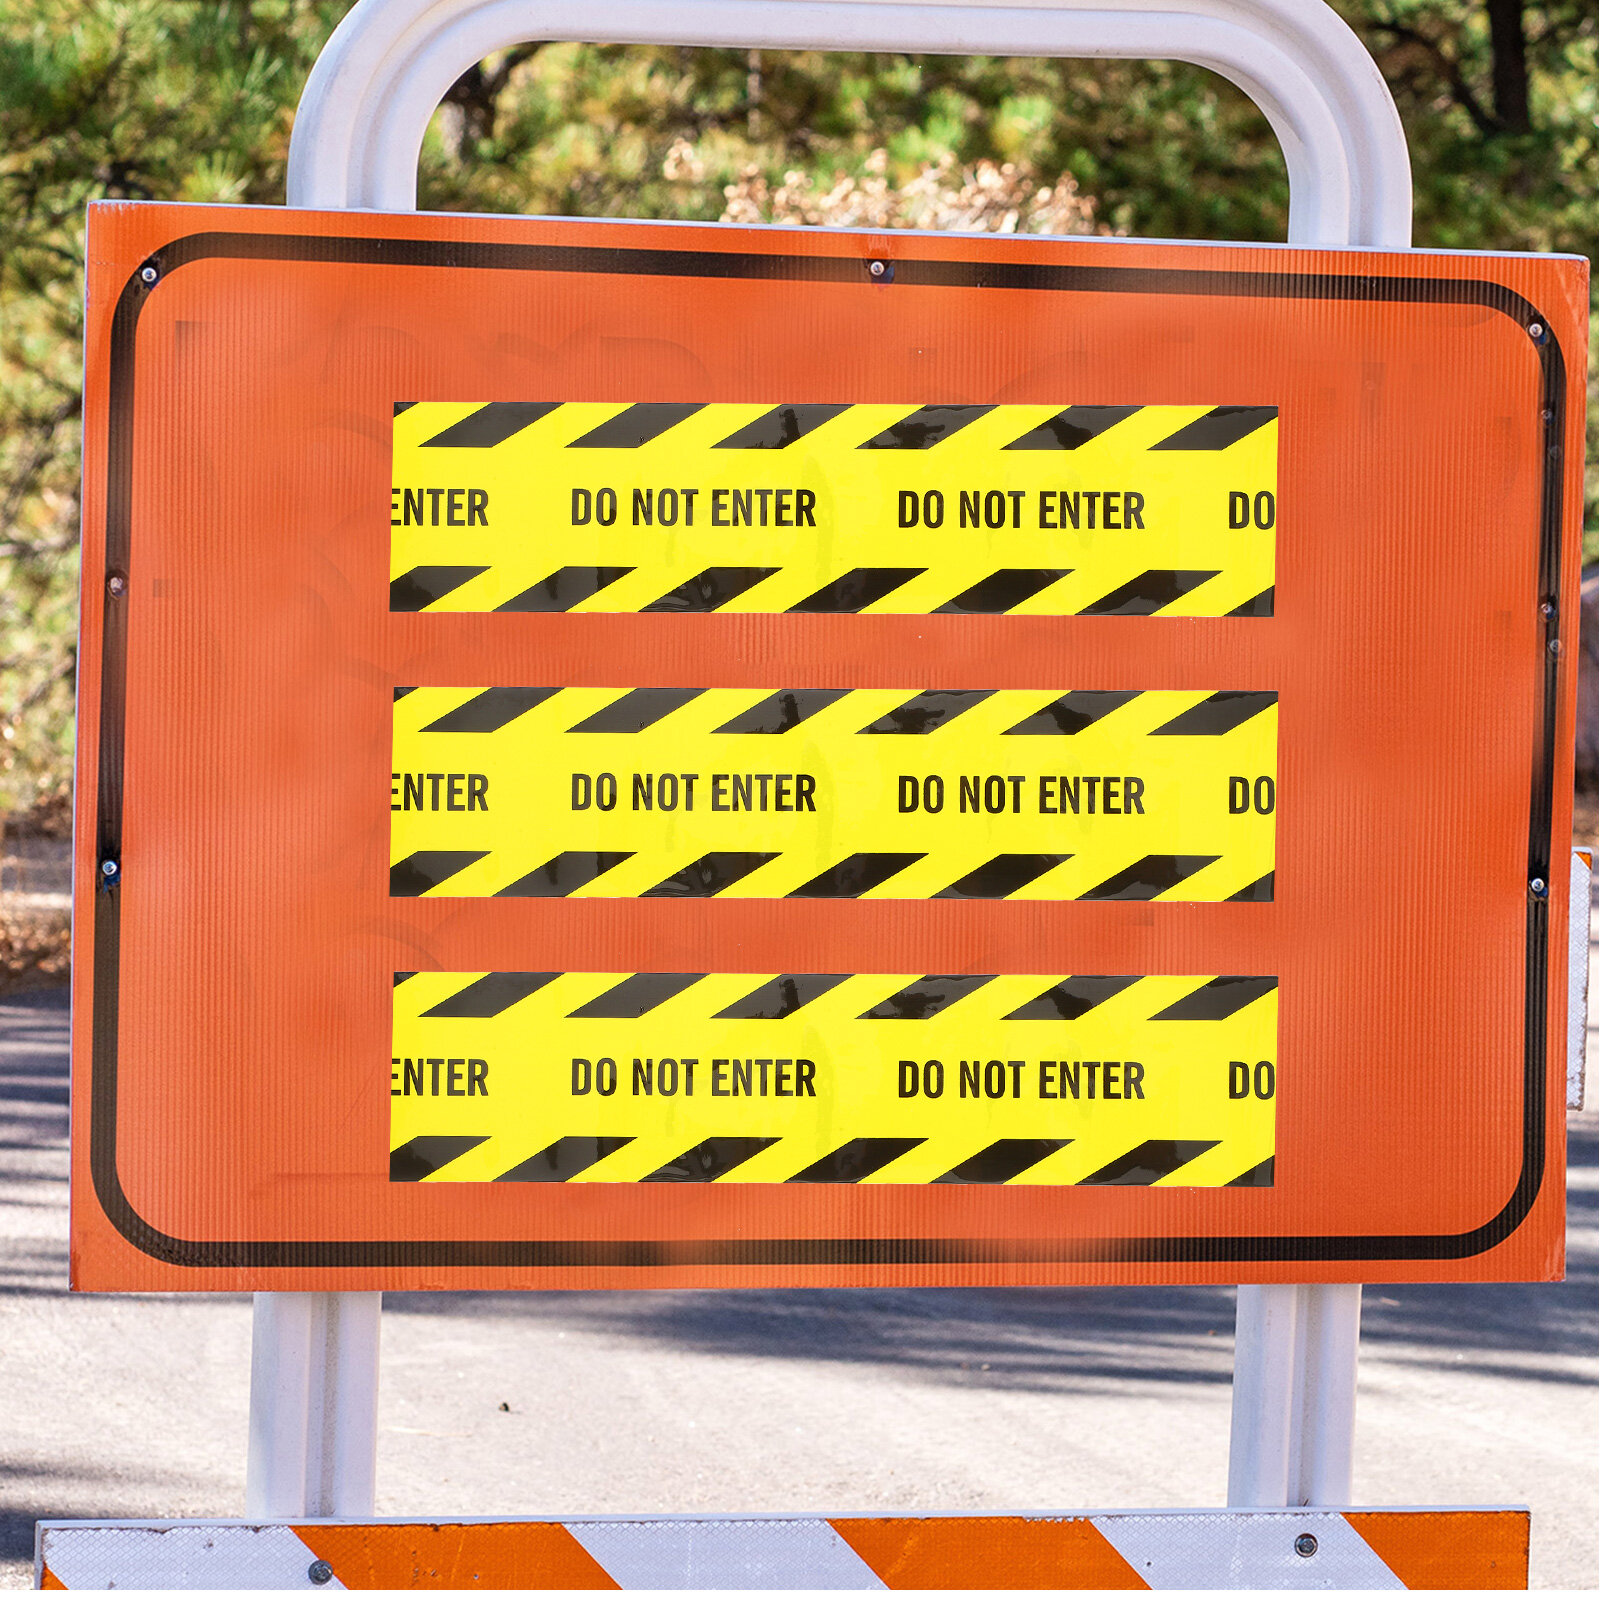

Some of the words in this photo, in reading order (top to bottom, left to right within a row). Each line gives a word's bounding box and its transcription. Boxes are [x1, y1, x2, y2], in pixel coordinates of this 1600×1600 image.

[571, 488, 617, 527] DO
[633, 489, 699, 527] NOT
[711, 489, 817, 527] ENTER
[898, 490, 944, 528] DO
[960, 490, 1025, 529] NOT
[1040, 491, 1145, 530] ENTER
[1229, 491, 1275, 530] DO
[571, 773, 617, 812] DO
[633, 774, 699, 812] NOT
[711, 774, 817, 812] ENTER
[898, 775, 944, 813] DO
[960, 775, 1025, 814] NOT
[1040, 776, 1145, 815] ENTER
[1229, 776, 1275, 815] DO
[571, 1058, 617, 1097] DO
[633, 1059, 699, 1097] NOT
[711, 1059, 817, 1097] ENTER
[898, 1060, 944, 1098] DO
[960, 1060, 1025, 1099] NOT
[1040, 1061, 1145, 1100] ENTER
[1229, 1061, 1275, 1100] DO
